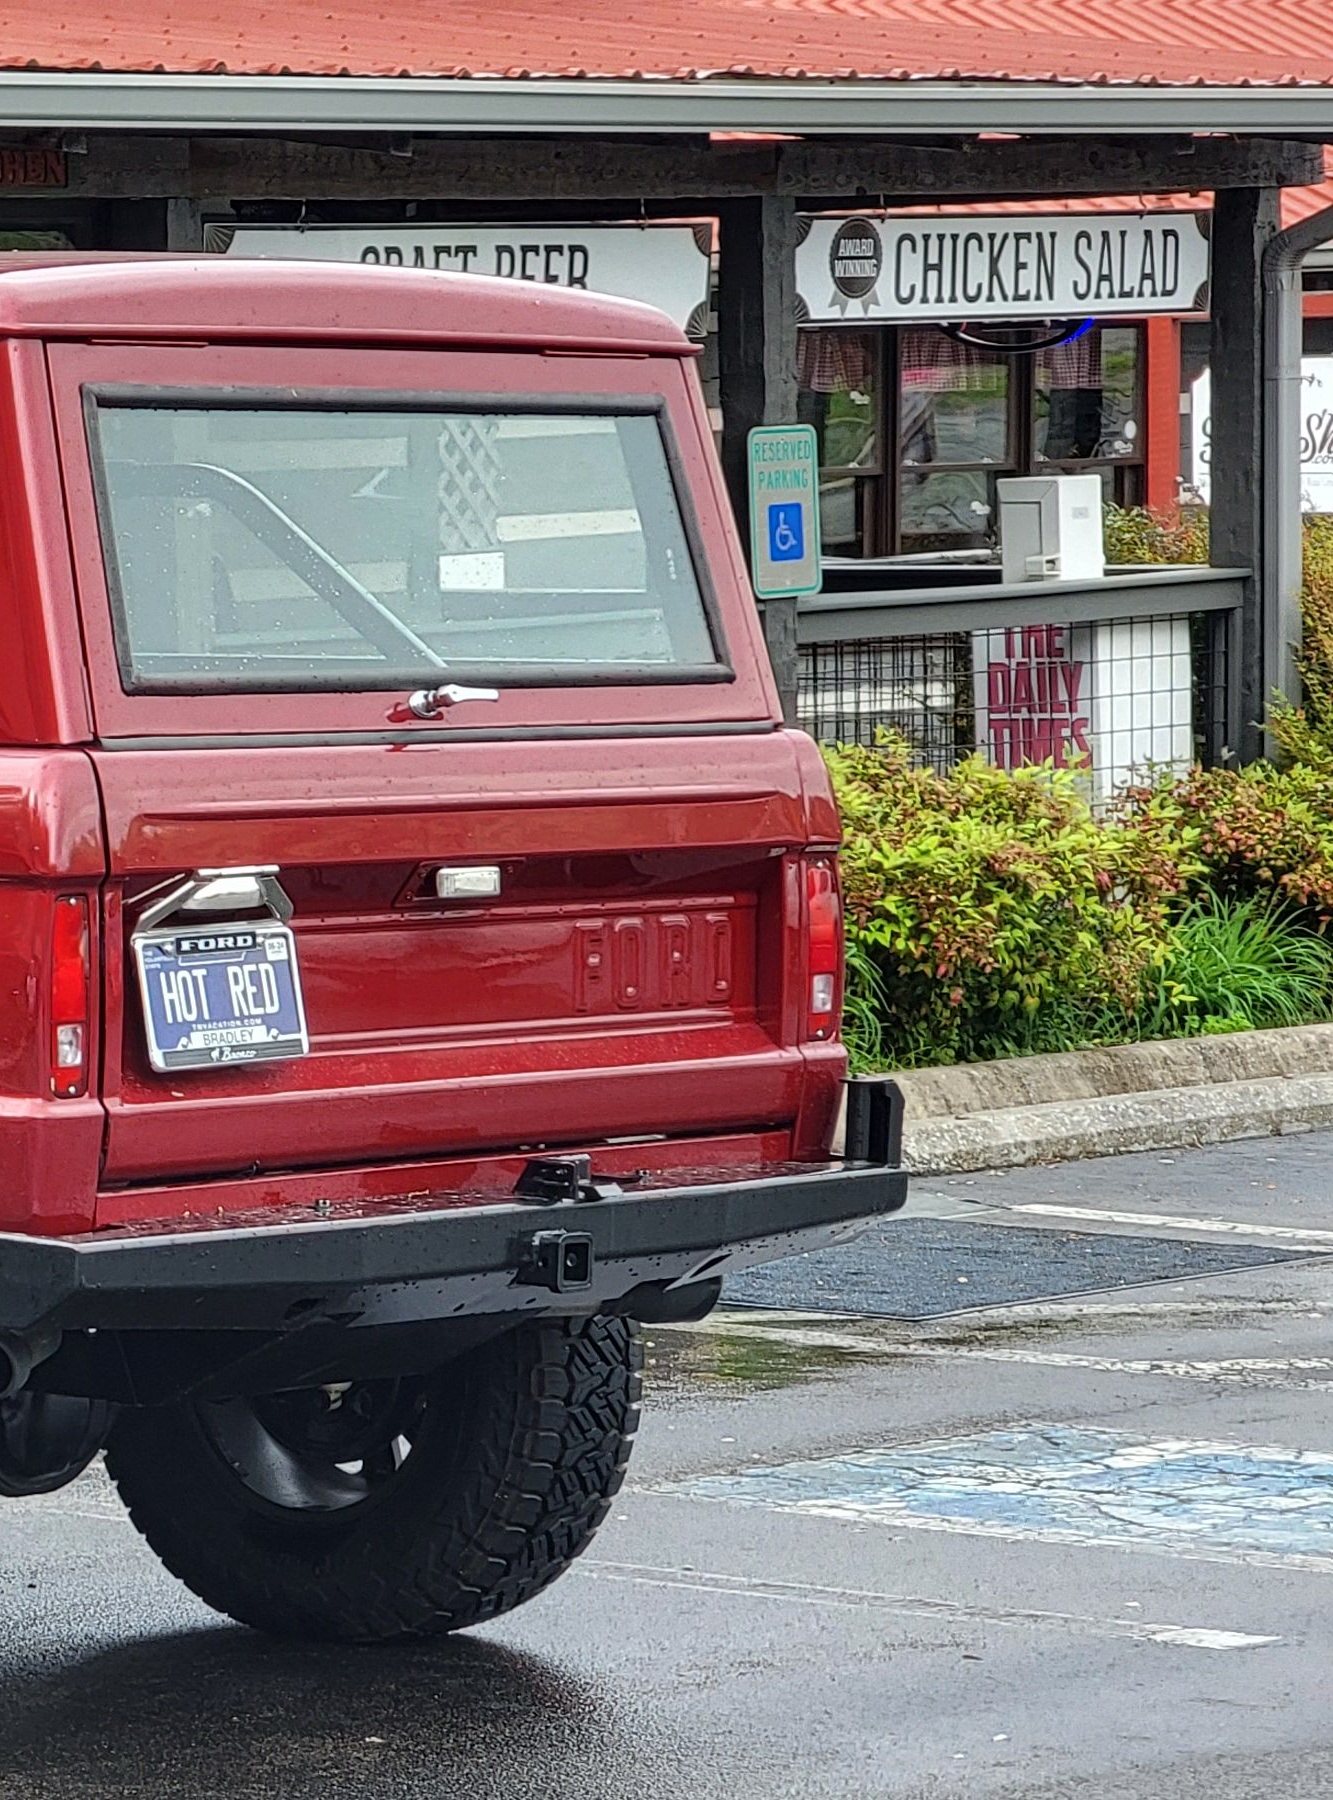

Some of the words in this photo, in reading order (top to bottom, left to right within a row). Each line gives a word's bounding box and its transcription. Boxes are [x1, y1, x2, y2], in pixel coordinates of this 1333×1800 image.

[838, 238, 874, 256] AWARD
[835, 259, 878, 277] WINNING
[894, 230, 1057, 305] CHICKEN
[1073, 229, 1180, 299] SALAD
[754, 440, 811, 462] RESERVED
[758, 468, 808, 490] PARKING
[1005, 624, 1065, 658] THE
[989, 661, 1083, 713] DAILY
[989, 718, 1093, 770] TIMES
[180, 935, 253, 951] FORD
[160, 968, 210, 1023] HOT
[227, 963, 280, 1017] RED
[203, 1028, 254, 1046] BRADLEY
